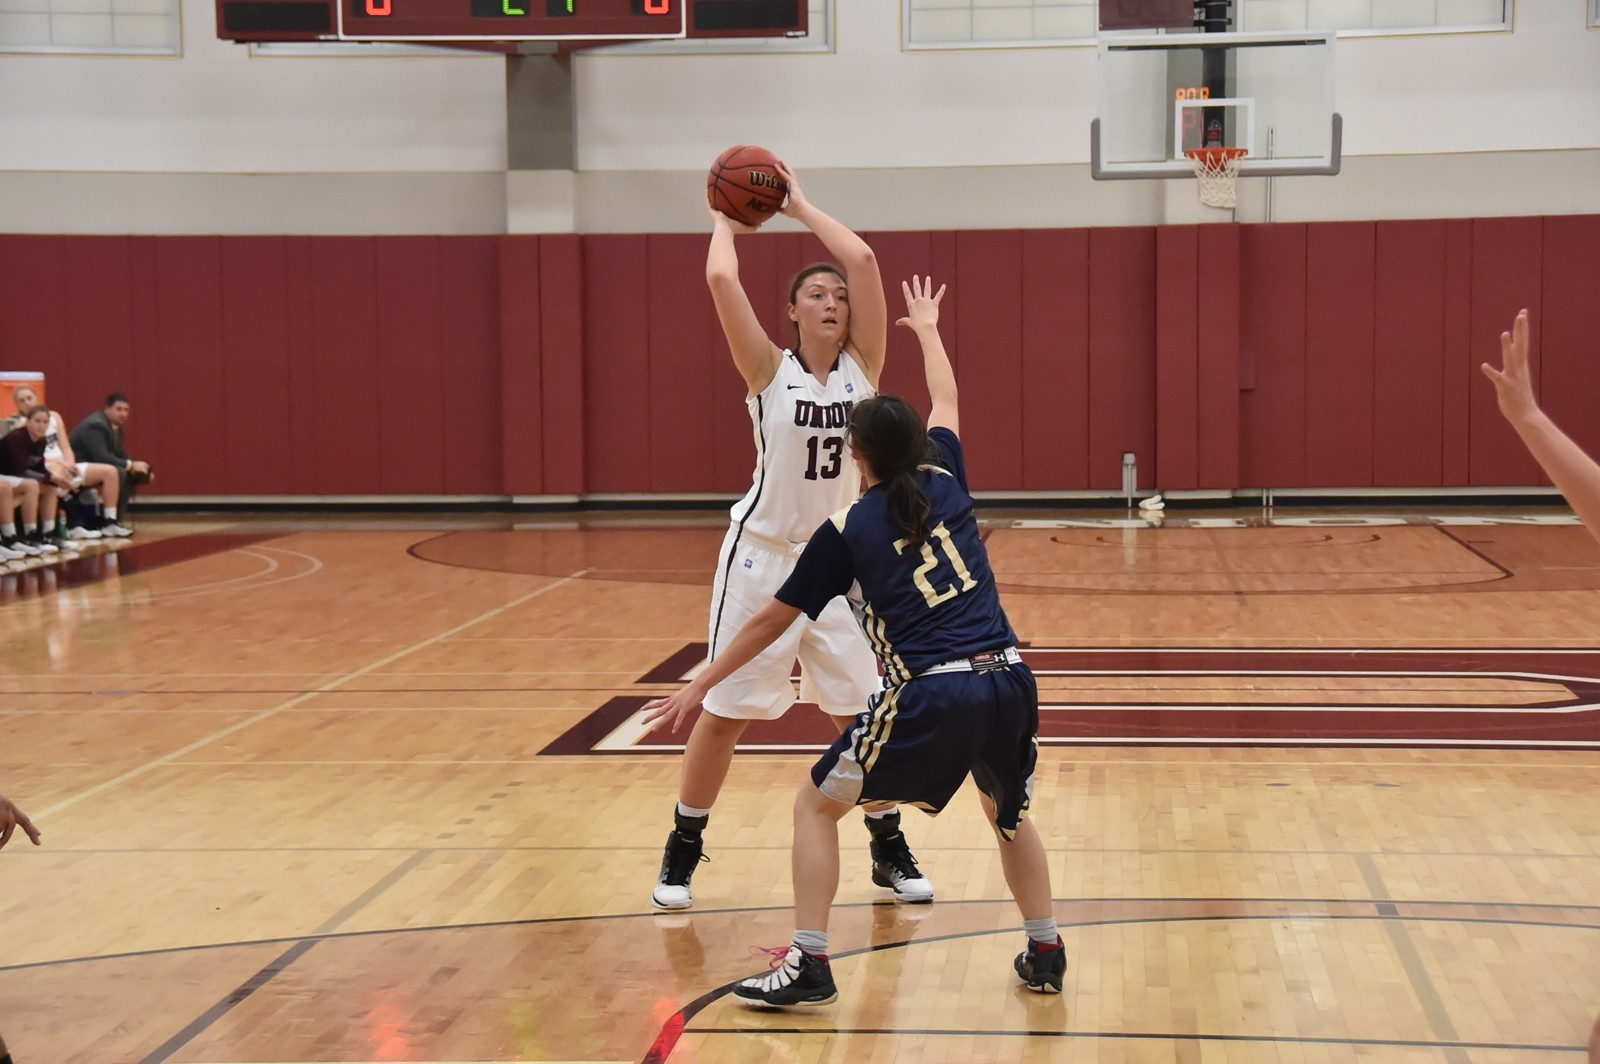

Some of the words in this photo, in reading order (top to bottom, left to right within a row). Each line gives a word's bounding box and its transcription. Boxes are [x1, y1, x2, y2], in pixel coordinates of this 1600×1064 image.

[804, 435, 844, 480] 13
[977, 515, 1586, 529] NION
[893, 521, 978, 608] 21
